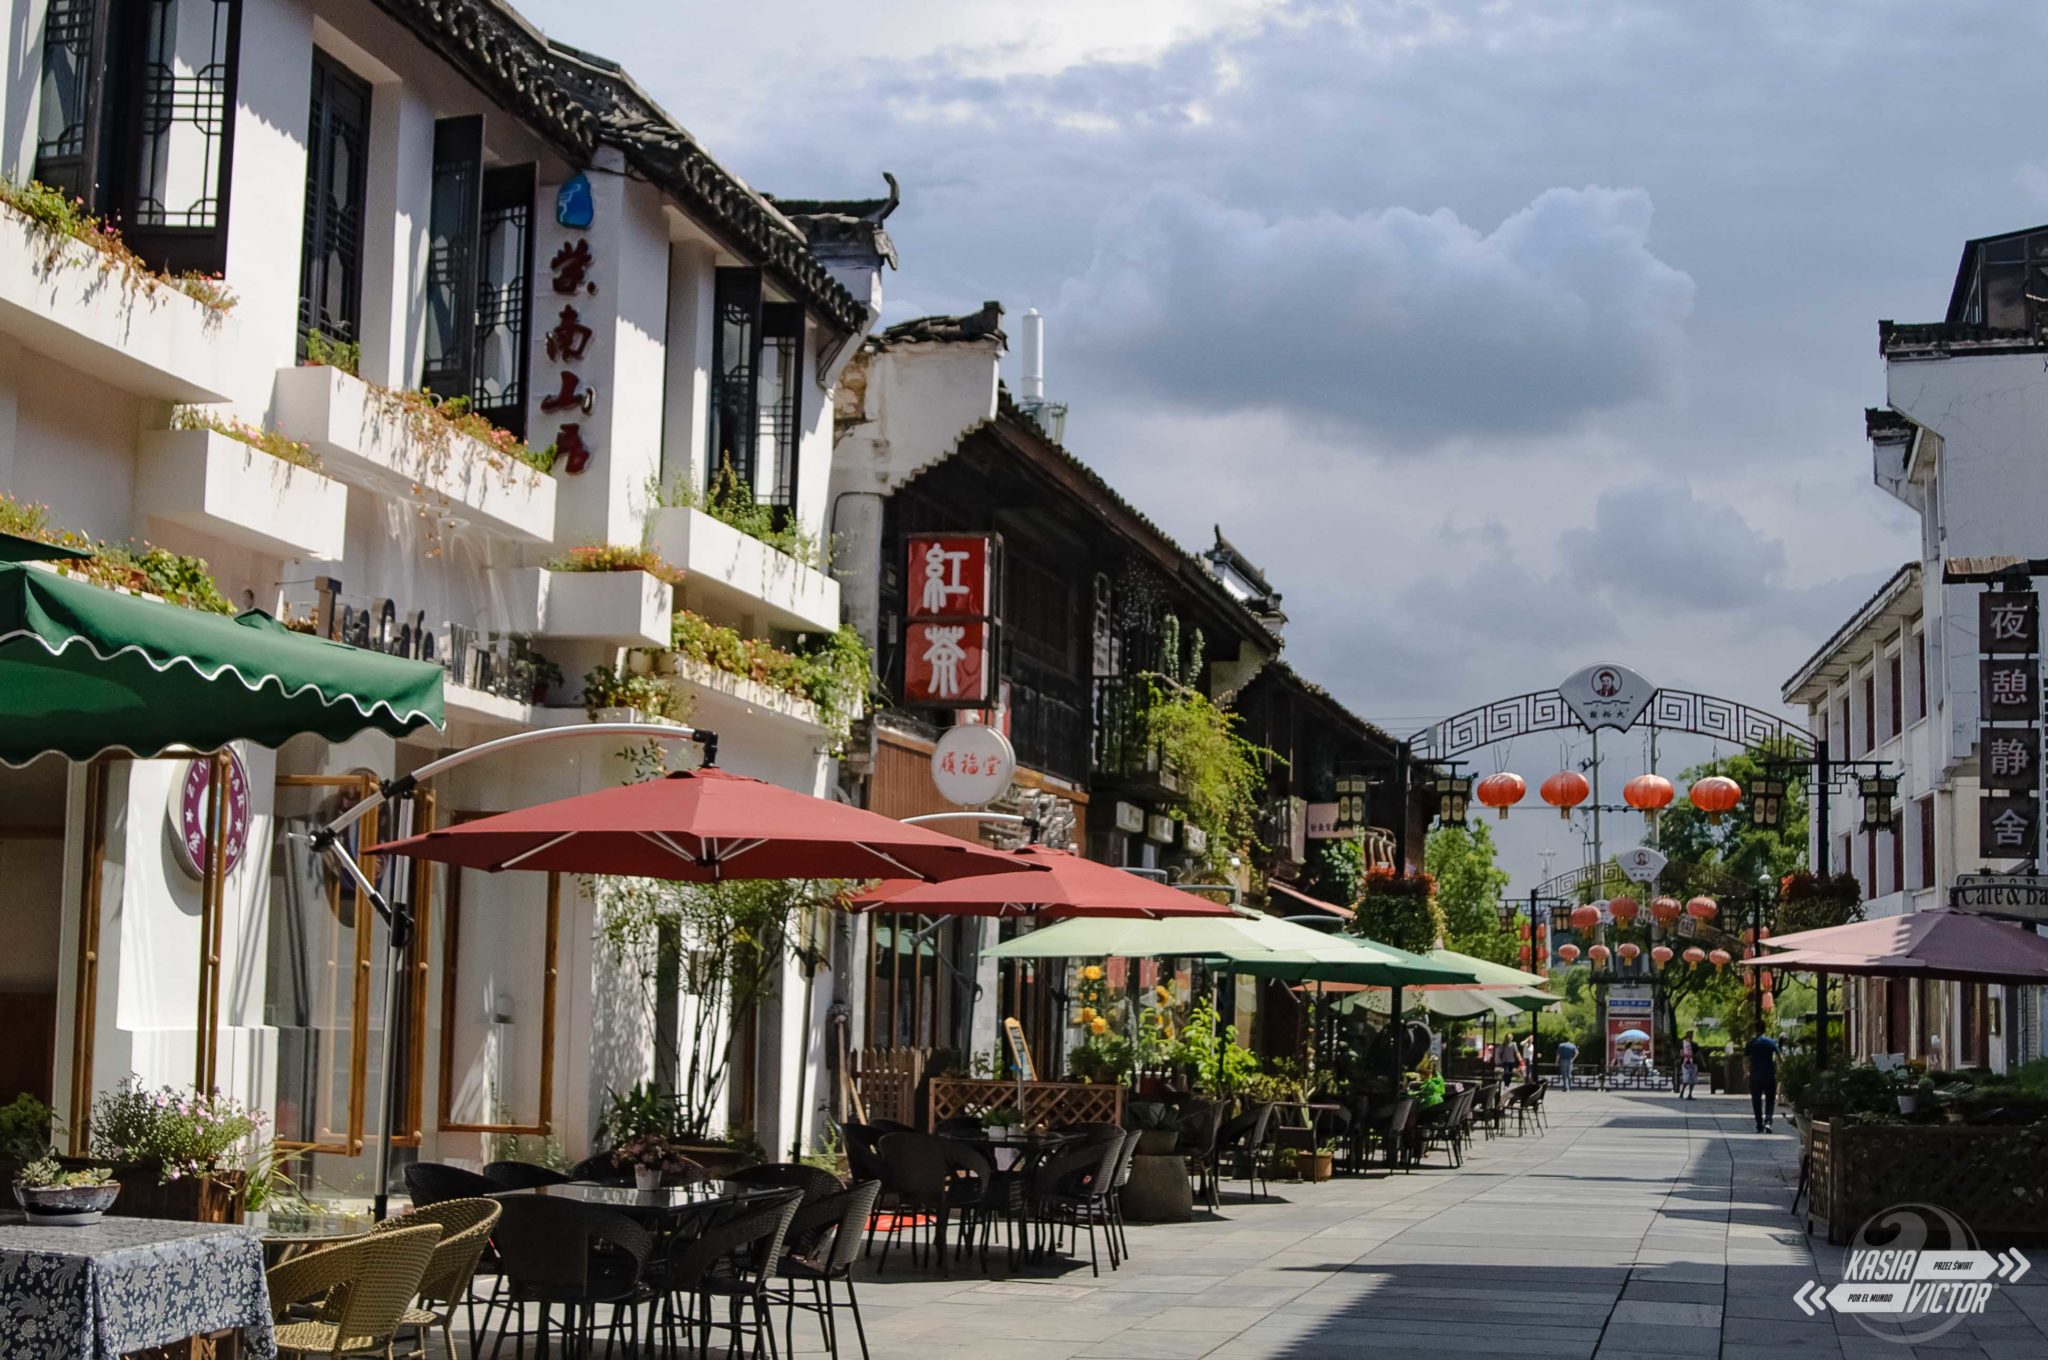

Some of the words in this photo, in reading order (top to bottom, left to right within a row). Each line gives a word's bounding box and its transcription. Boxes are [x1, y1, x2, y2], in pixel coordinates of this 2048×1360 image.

[922, 542, 970, 699] 紅茶
[1990, 603, 2029, 846] 夜憩静舍
